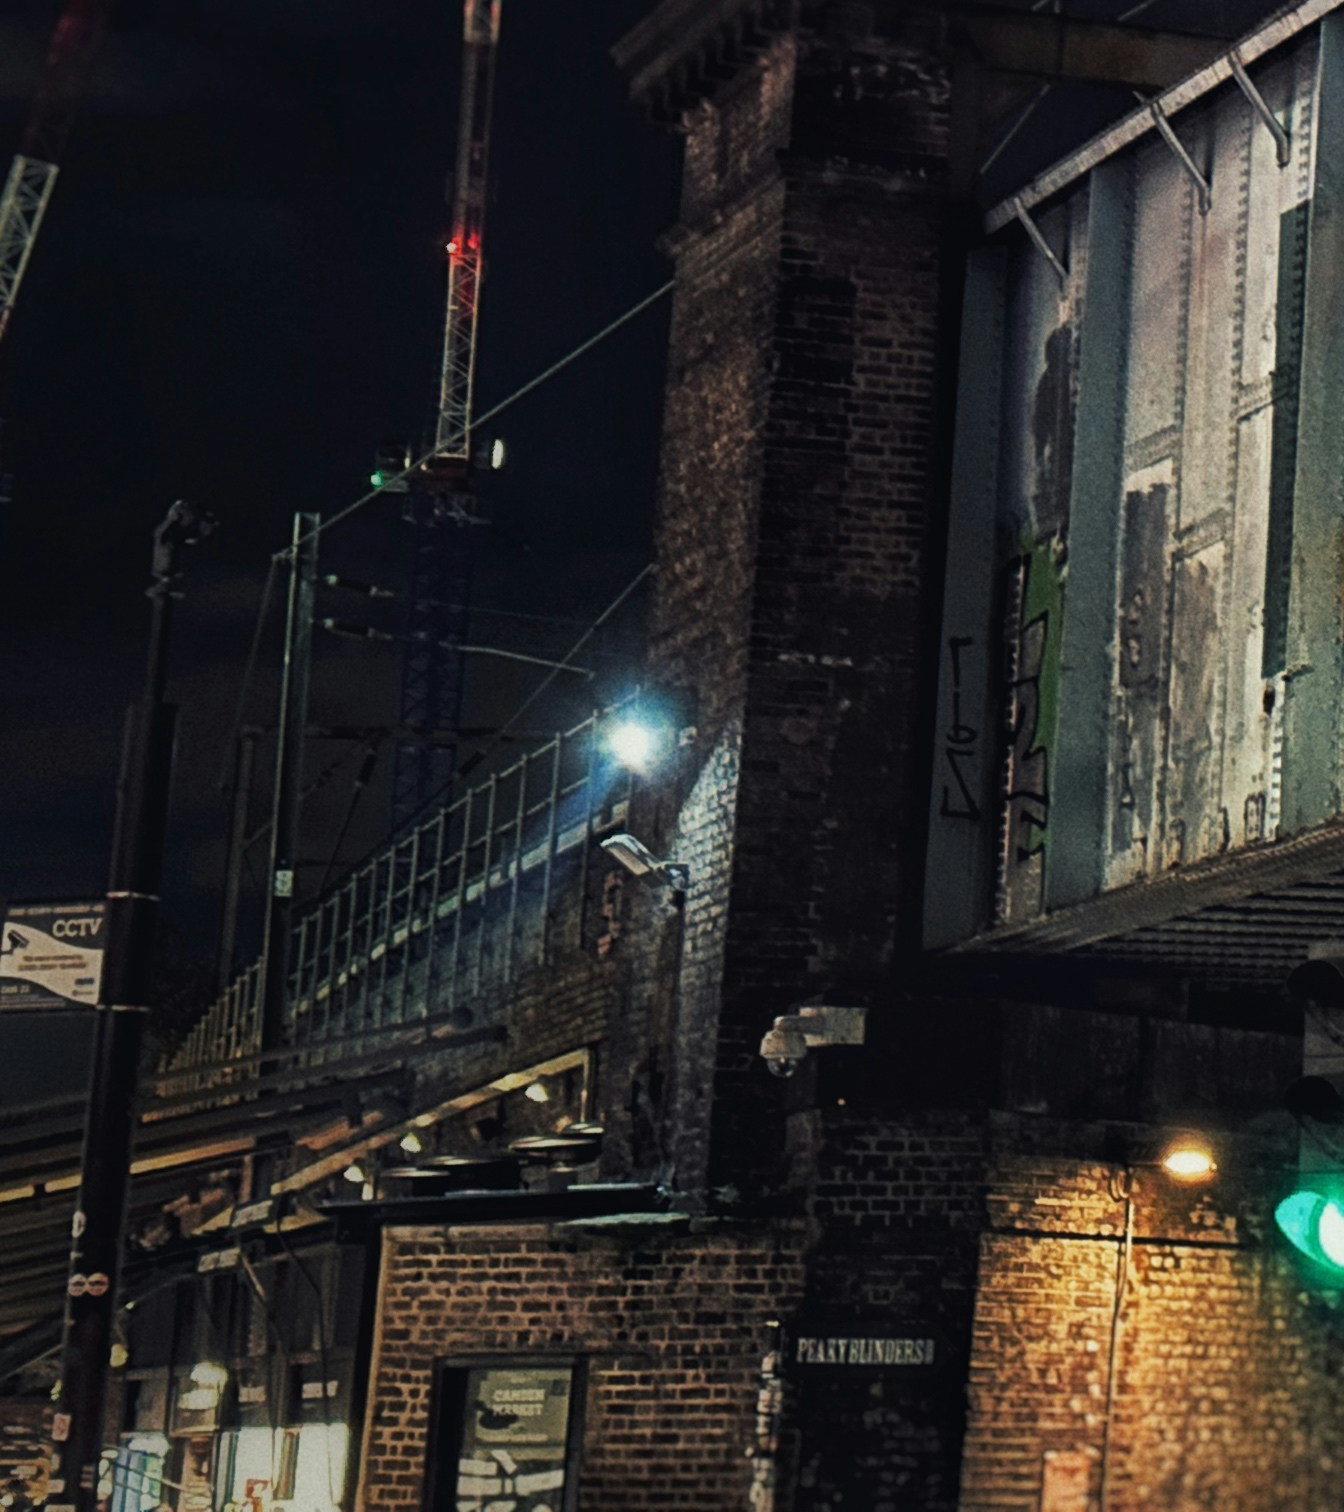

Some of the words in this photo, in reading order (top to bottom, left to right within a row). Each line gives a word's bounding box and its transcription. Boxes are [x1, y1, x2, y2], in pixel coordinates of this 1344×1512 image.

[52, 918, 102, 938] CCTV
[797, 1337, 847, 1364] PEAKY
[848, 1338, 925, 1365] BLINDERS
